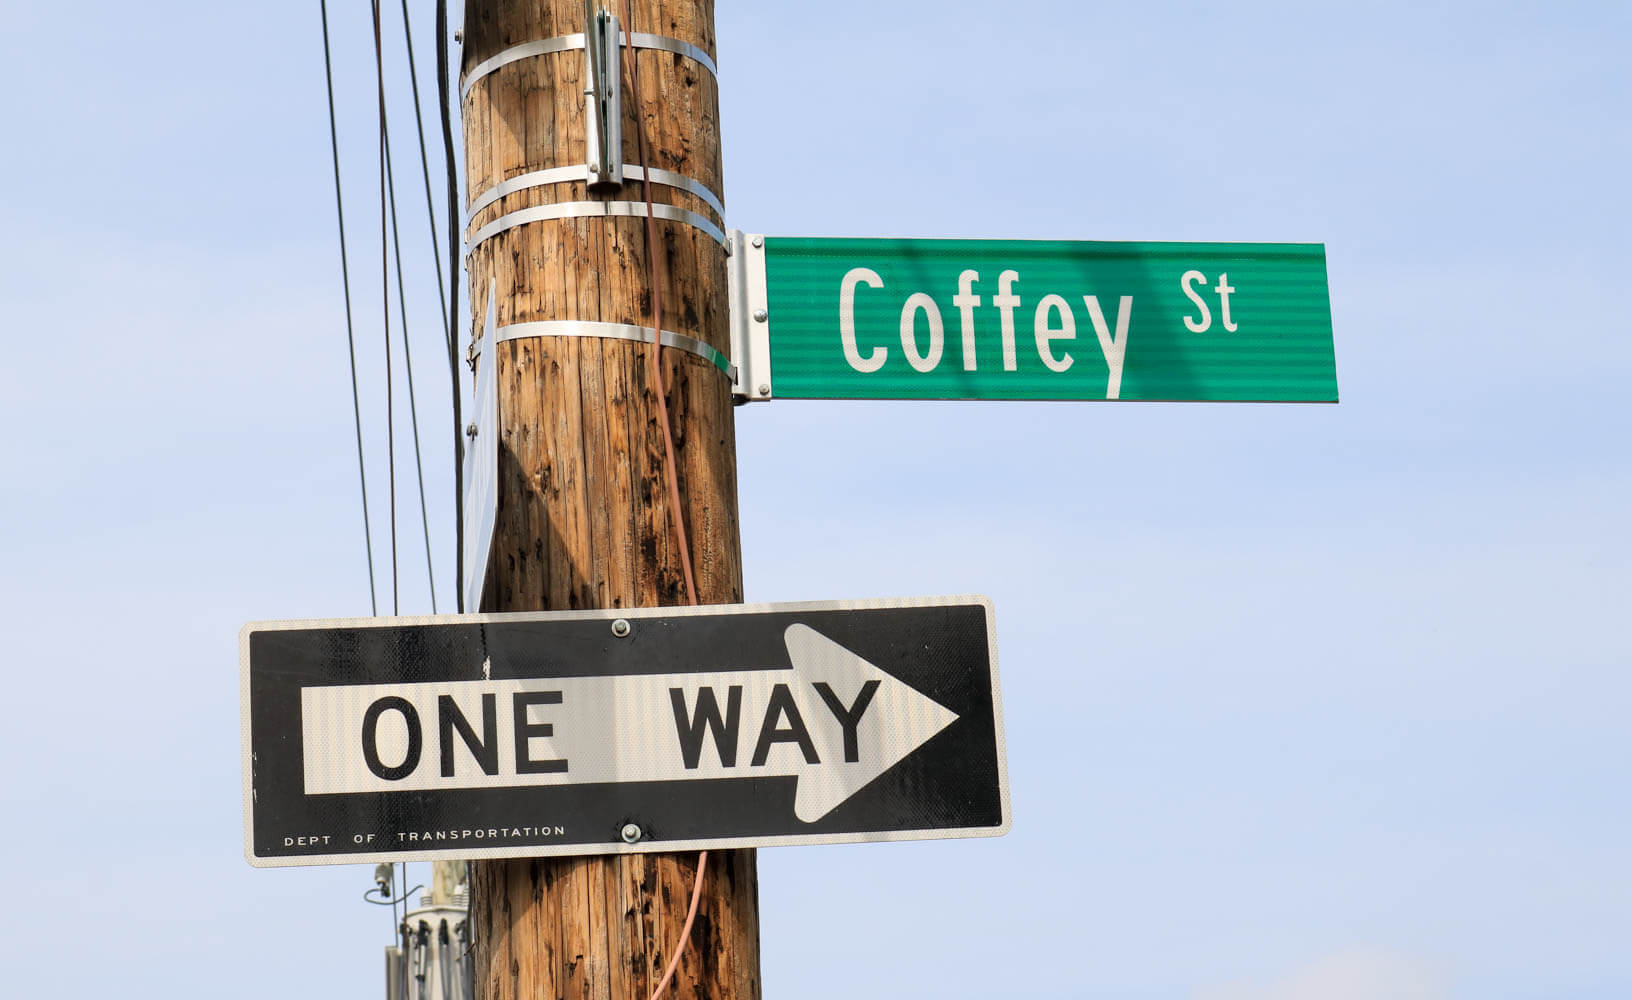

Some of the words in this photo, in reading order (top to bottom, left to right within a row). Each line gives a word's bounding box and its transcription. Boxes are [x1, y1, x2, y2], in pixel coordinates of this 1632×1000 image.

[839, 267, 1134, 400] Coffey
[1180, 269, 1239, 334] St
[360, 690, 569, 782] ONE
[668, 679, 883, 770] WAY
[283, 834, 332, 847] DEPT
[353, 833, 376, 844] OF
[397, 825, 566, 842] TRANSPORTATION
